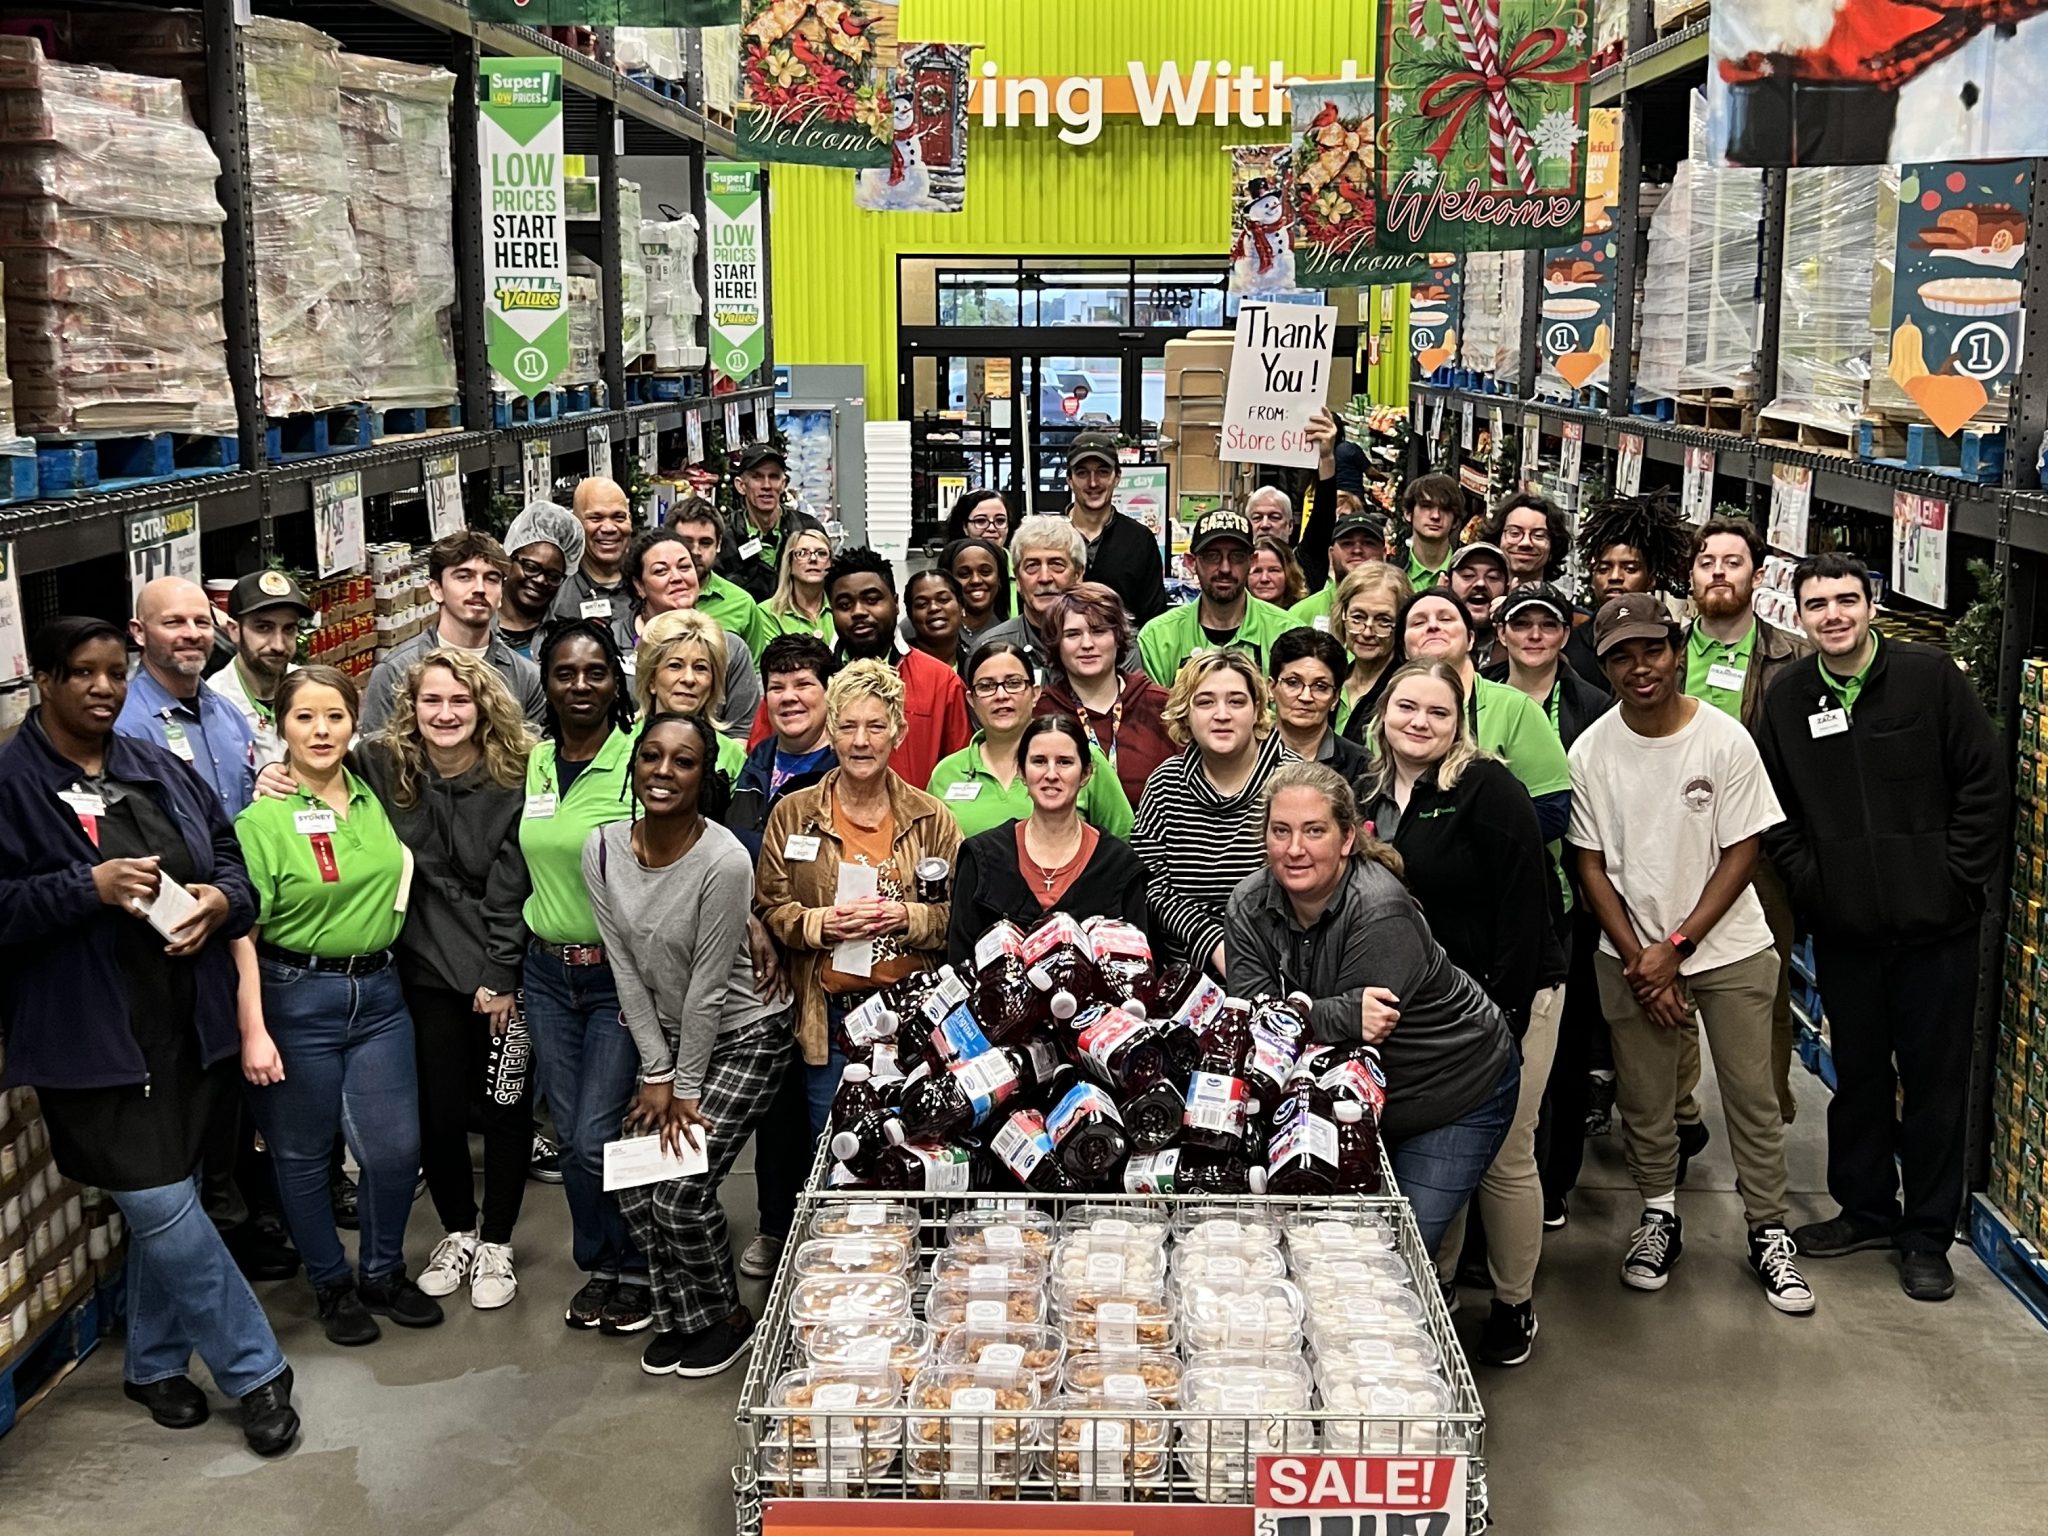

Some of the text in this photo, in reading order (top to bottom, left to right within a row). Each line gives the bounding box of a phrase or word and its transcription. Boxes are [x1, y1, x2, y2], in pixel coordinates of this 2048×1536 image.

[513, 92, 542, 103] PRICES
[749, 93, 880, 152] Welcome
[1590, 142, 1615, 152] kful
[492, 153, 555, 187] LOW
[492, 190, 557, 212] PRICES
[1387, 171, 1581, 242] Welcome
[493, 214, 557, 239] START
[713, 224, 755, 246] LOW
[495, 242, 559, 268] HERE!
[713, 248, 756, 262] PRICES
[1304, 225, 1425, 274] Welcome
[714, 264, 756, 279] START
[496, 276, 554, 293] WALL
[715, 281, 757, 298] HERE!
[495, 289, 560, 310] Values
[716, 313, 757, 325] Values
[1241, 306, 1328, 350] Thank
[1248, 405, 1289, 421] FROM:
[1227, 424, 1275, 450] Store
[1133, 475, 1155, 490] day
[132, 516, 168, 544] EXTRA
[298, 814, 331, 822] SYDNEY
[956, 1008, 977, 1041] Original
[486, 1036, 501, 1096] ORNIA
[1269, 1459, 1436, 1504] SALE!
